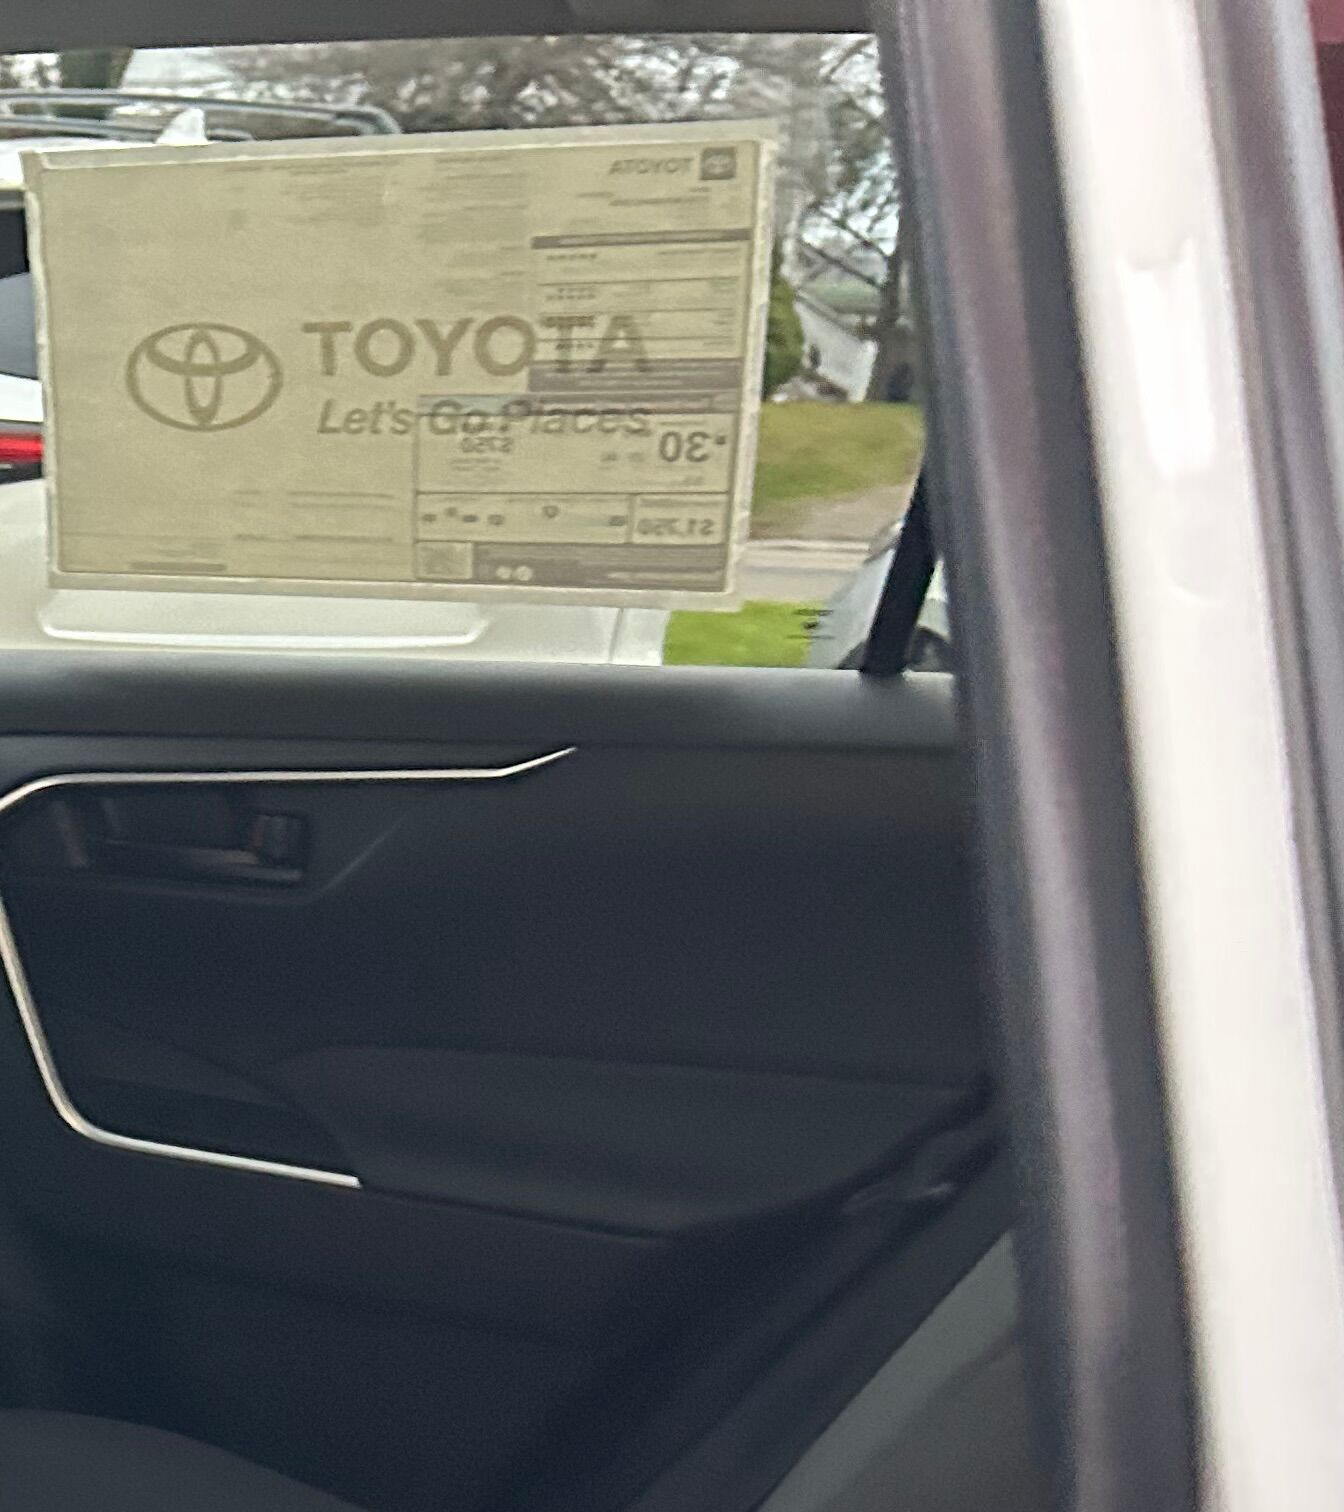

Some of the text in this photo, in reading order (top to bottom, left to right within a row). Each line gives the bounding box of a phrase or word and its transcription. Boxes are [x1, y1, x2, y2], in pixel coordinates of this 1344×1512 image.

[302, 317, 653, 377] TOYOTA
[318, 399, 411, 435] Let's
[427, 400, 496, 436] Go
[501, 401, 653, 437] Places
